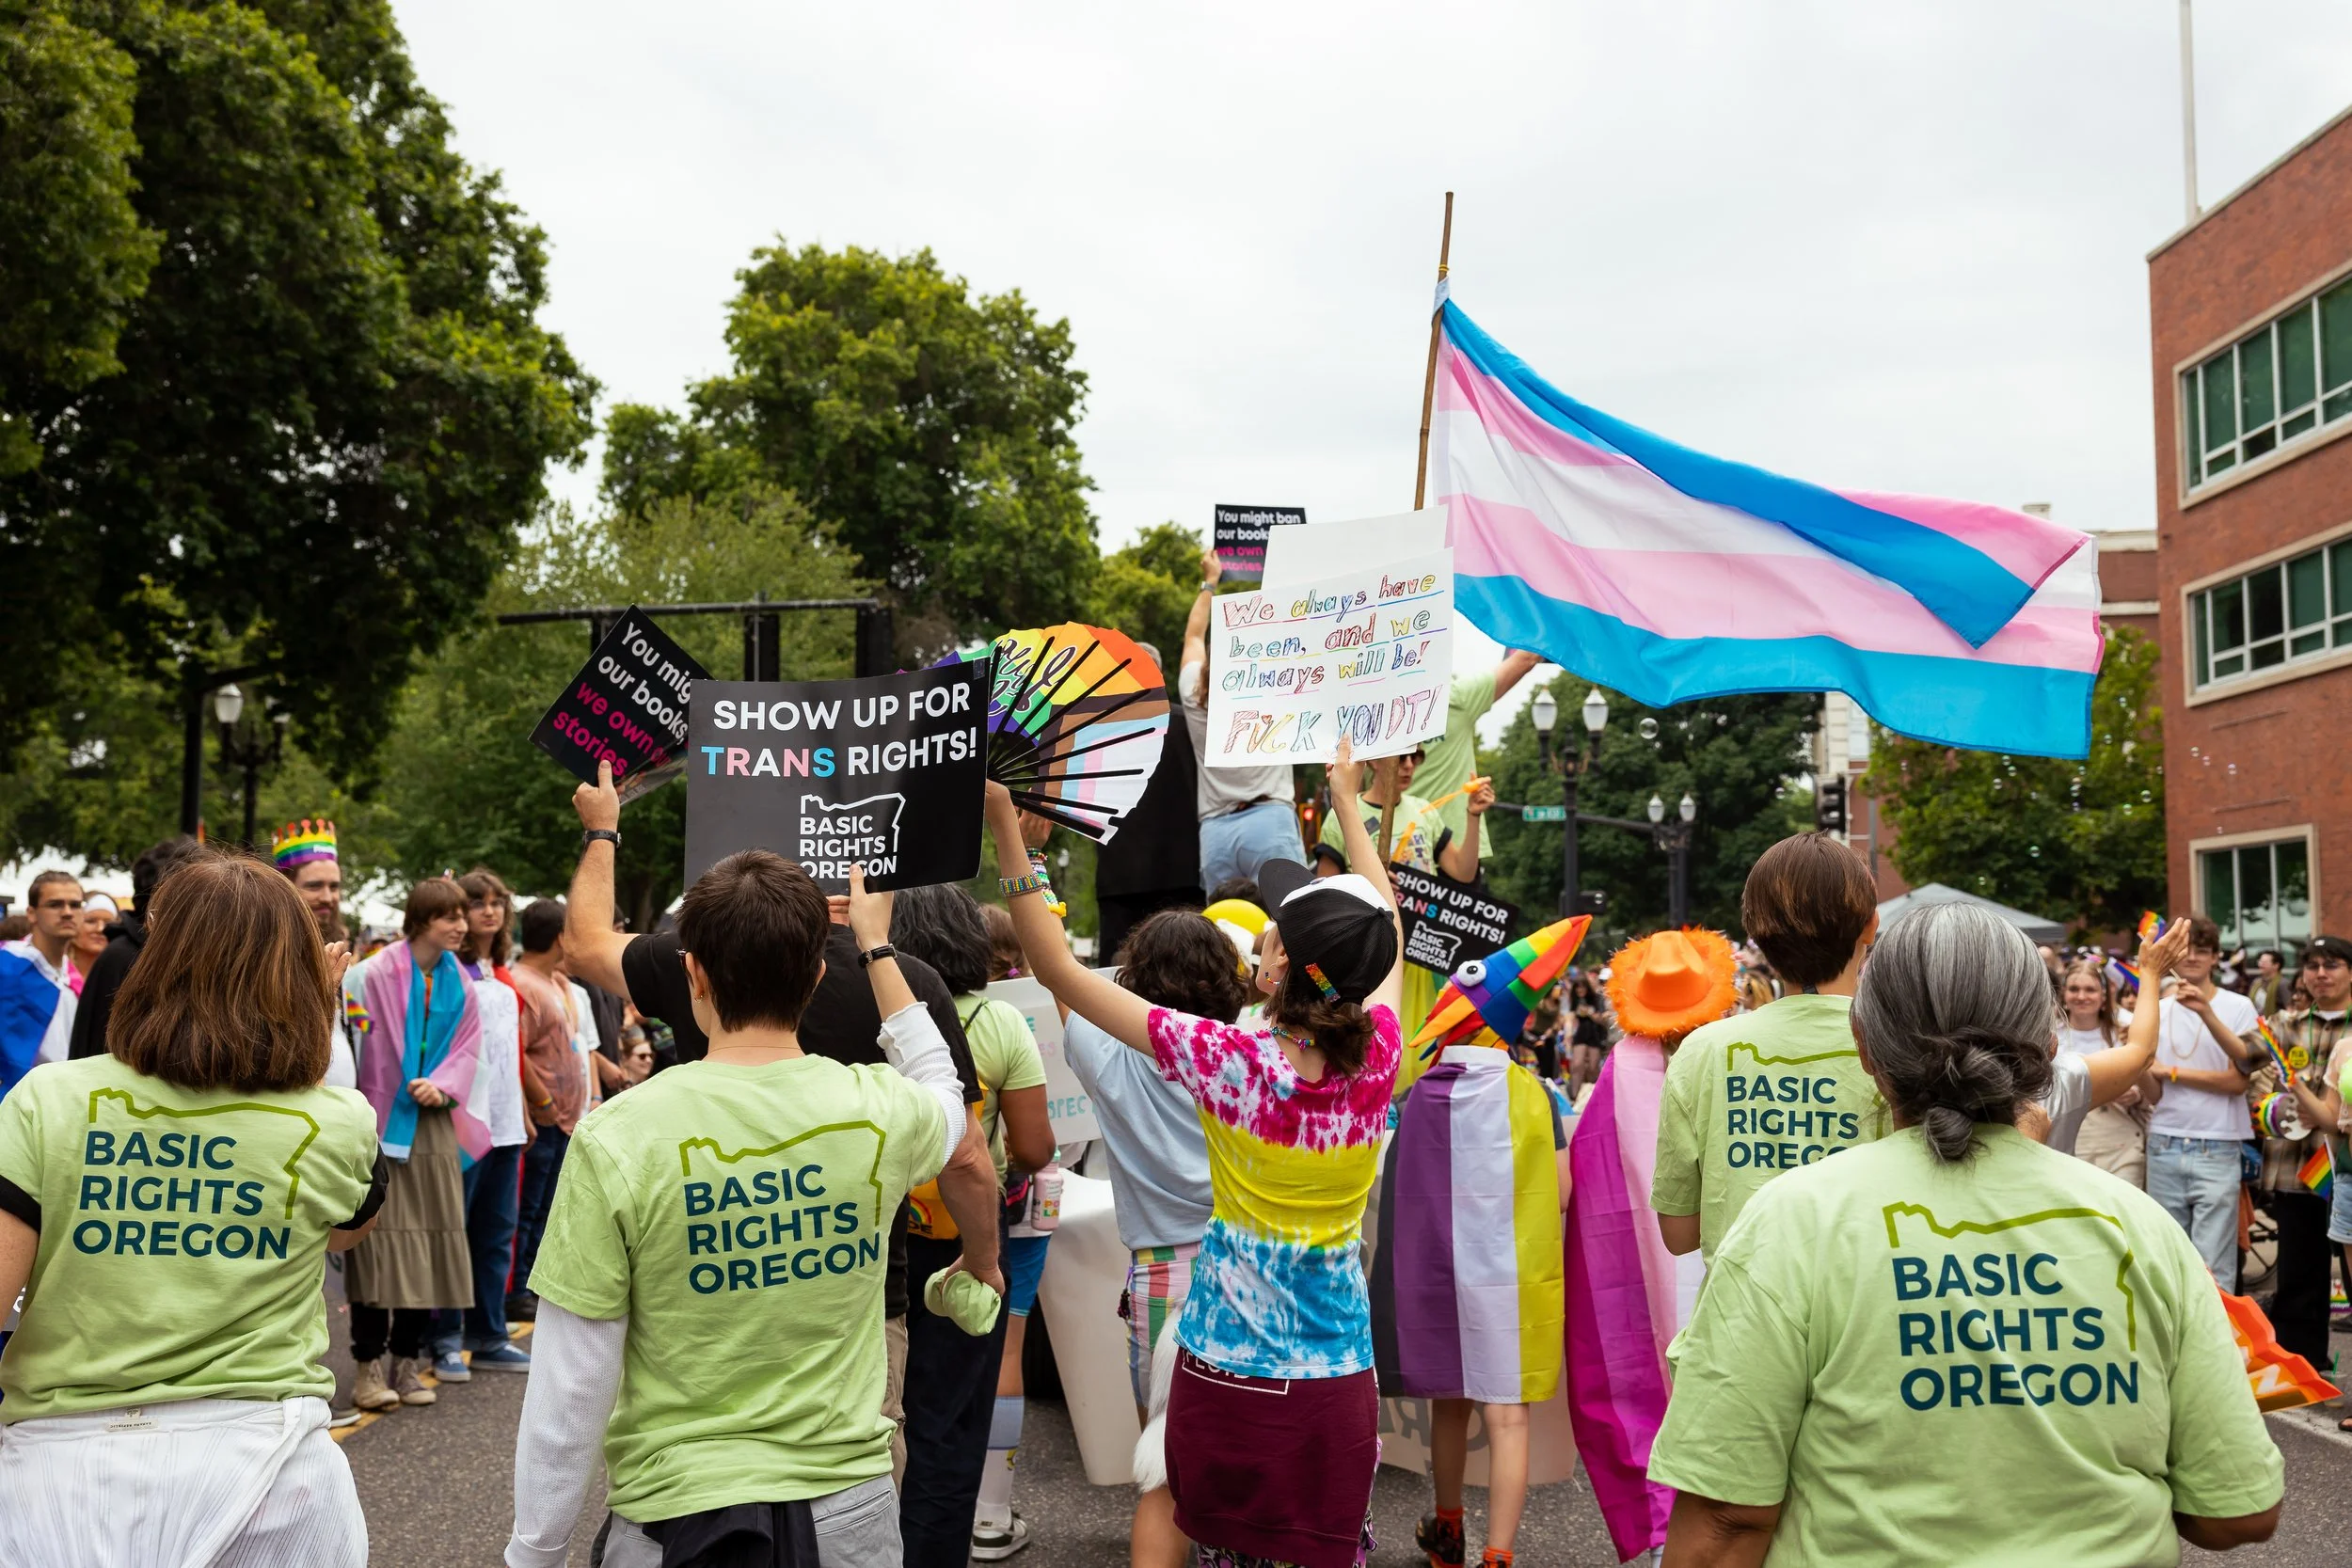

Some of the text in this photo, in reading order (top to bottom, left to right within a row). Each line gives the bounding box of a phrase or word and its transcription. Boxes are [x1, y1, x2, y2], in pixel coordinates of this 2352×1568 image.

[1216, 527, 1269, 541] our book
[1217, 510, 1301, 527] You might ban
[1216, 546, 1263, 556] we own
[1223, 575, 1435, 627] We always have
[1230, 610, 1430, 657] been, and we
[621, 622, 691, 705] You mig
[1222, 641, 1430, 694] always will be!
[576, 682, 609, 715] we
[609, 710, 654, 753] own
[597, 656, 689, 745] our books,
[713, 682, 970, 731] SHOW UP FOR
[701, 727, 977, 777] TRANS RIGHTS!
[800, 816, 873, 835] BASIC
[800, 835, 885, 857] RIGHTS
[1395, 892, 1505, 944] RANS RIGHTS!
[1396, 871, 1508, 924] SHOW UP FOR
[1405, 947, 1451, 971] OREGON
[1408, 939, 1448, 959] RIGHTS
[1412, 929, 1444, 948] BASIC
[1047, 1096, 1098, 1119] SPEC
[1726, 1075, 1837, 1105] BASIC
[1727, 1108, 1859, 1140] RIGHTS
[84, 1131, 237, 1170] BASIC
[1727, 1141, 1850, 1170] OREG
[79, 1175, 265, 1216] RIGHTS
[684, 1164, 827, 1216] BASIC
[72, 1219, 292, 1259] OREGON
[688, 1202, 859, 1255] RIGHTS
[689, 1232, 880, 1294] OREGON
[1892, 1253, 2064, 1301] BASIC
[1899, 1307, 2106, 1356] RIGHTS
[1899, 1361, 2138, 1411] OREGON
